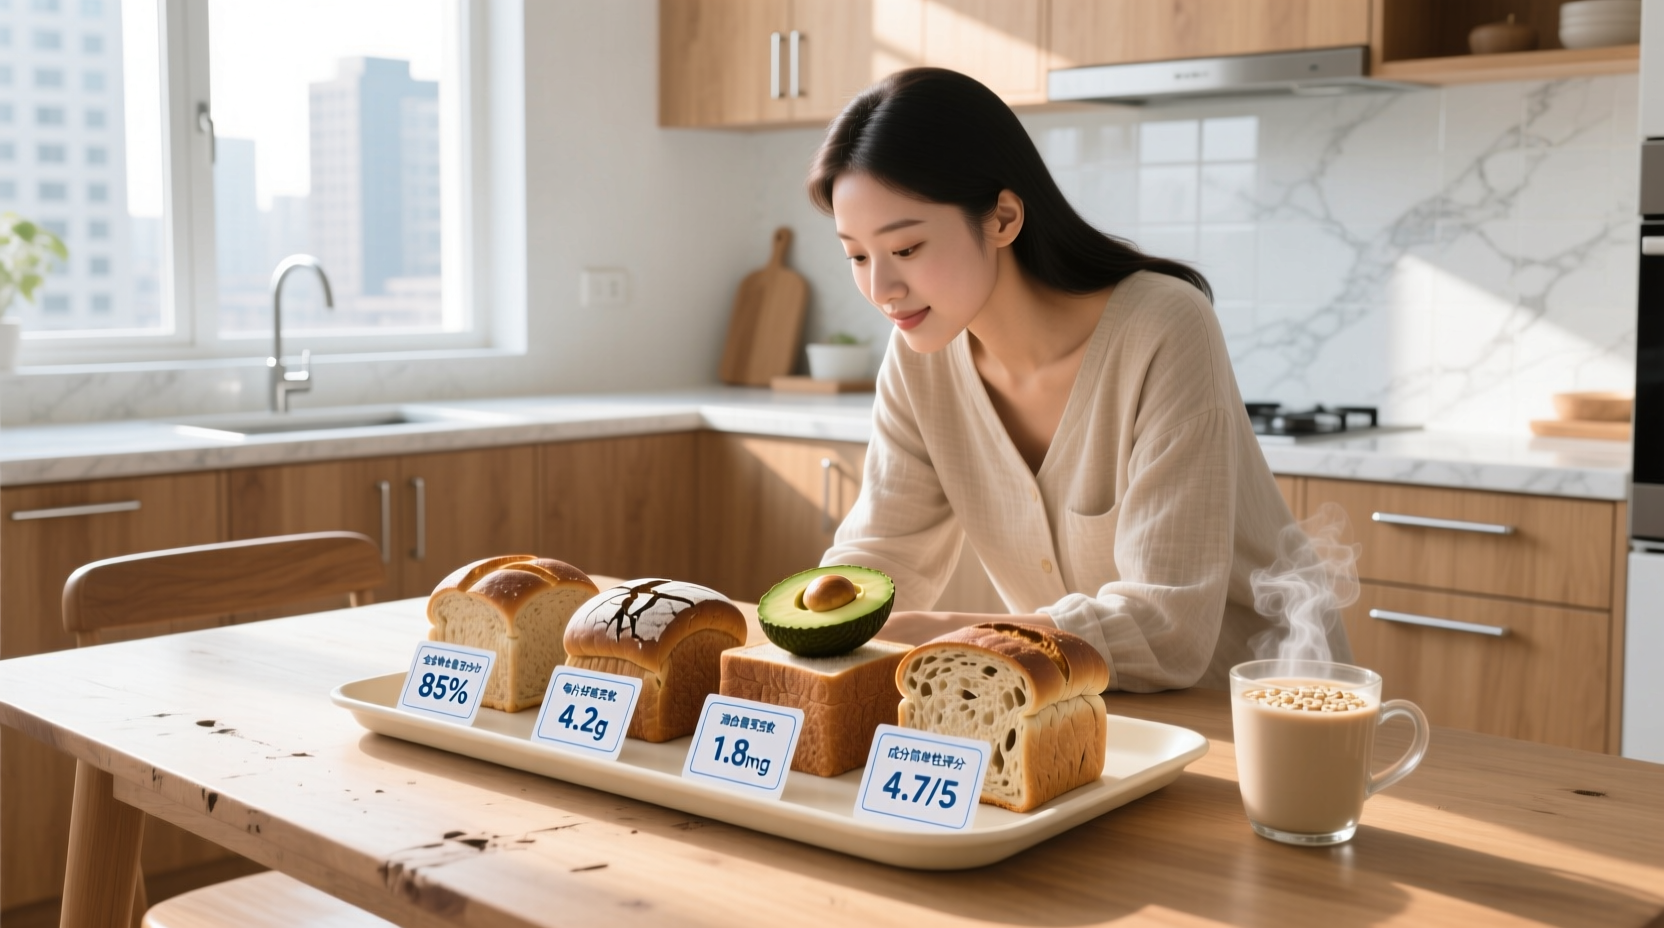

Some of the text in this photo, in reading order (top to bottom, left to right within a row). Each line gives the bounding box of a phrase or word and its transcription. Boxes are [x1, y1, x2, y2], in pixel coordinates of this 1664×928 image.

[418, 672, 468, 705] 85%
[558, 704, 609, 741] 4.2g
[714, 735, 771, 776] 1.8mg
[882, 771, 959, 809] 4.7/5
